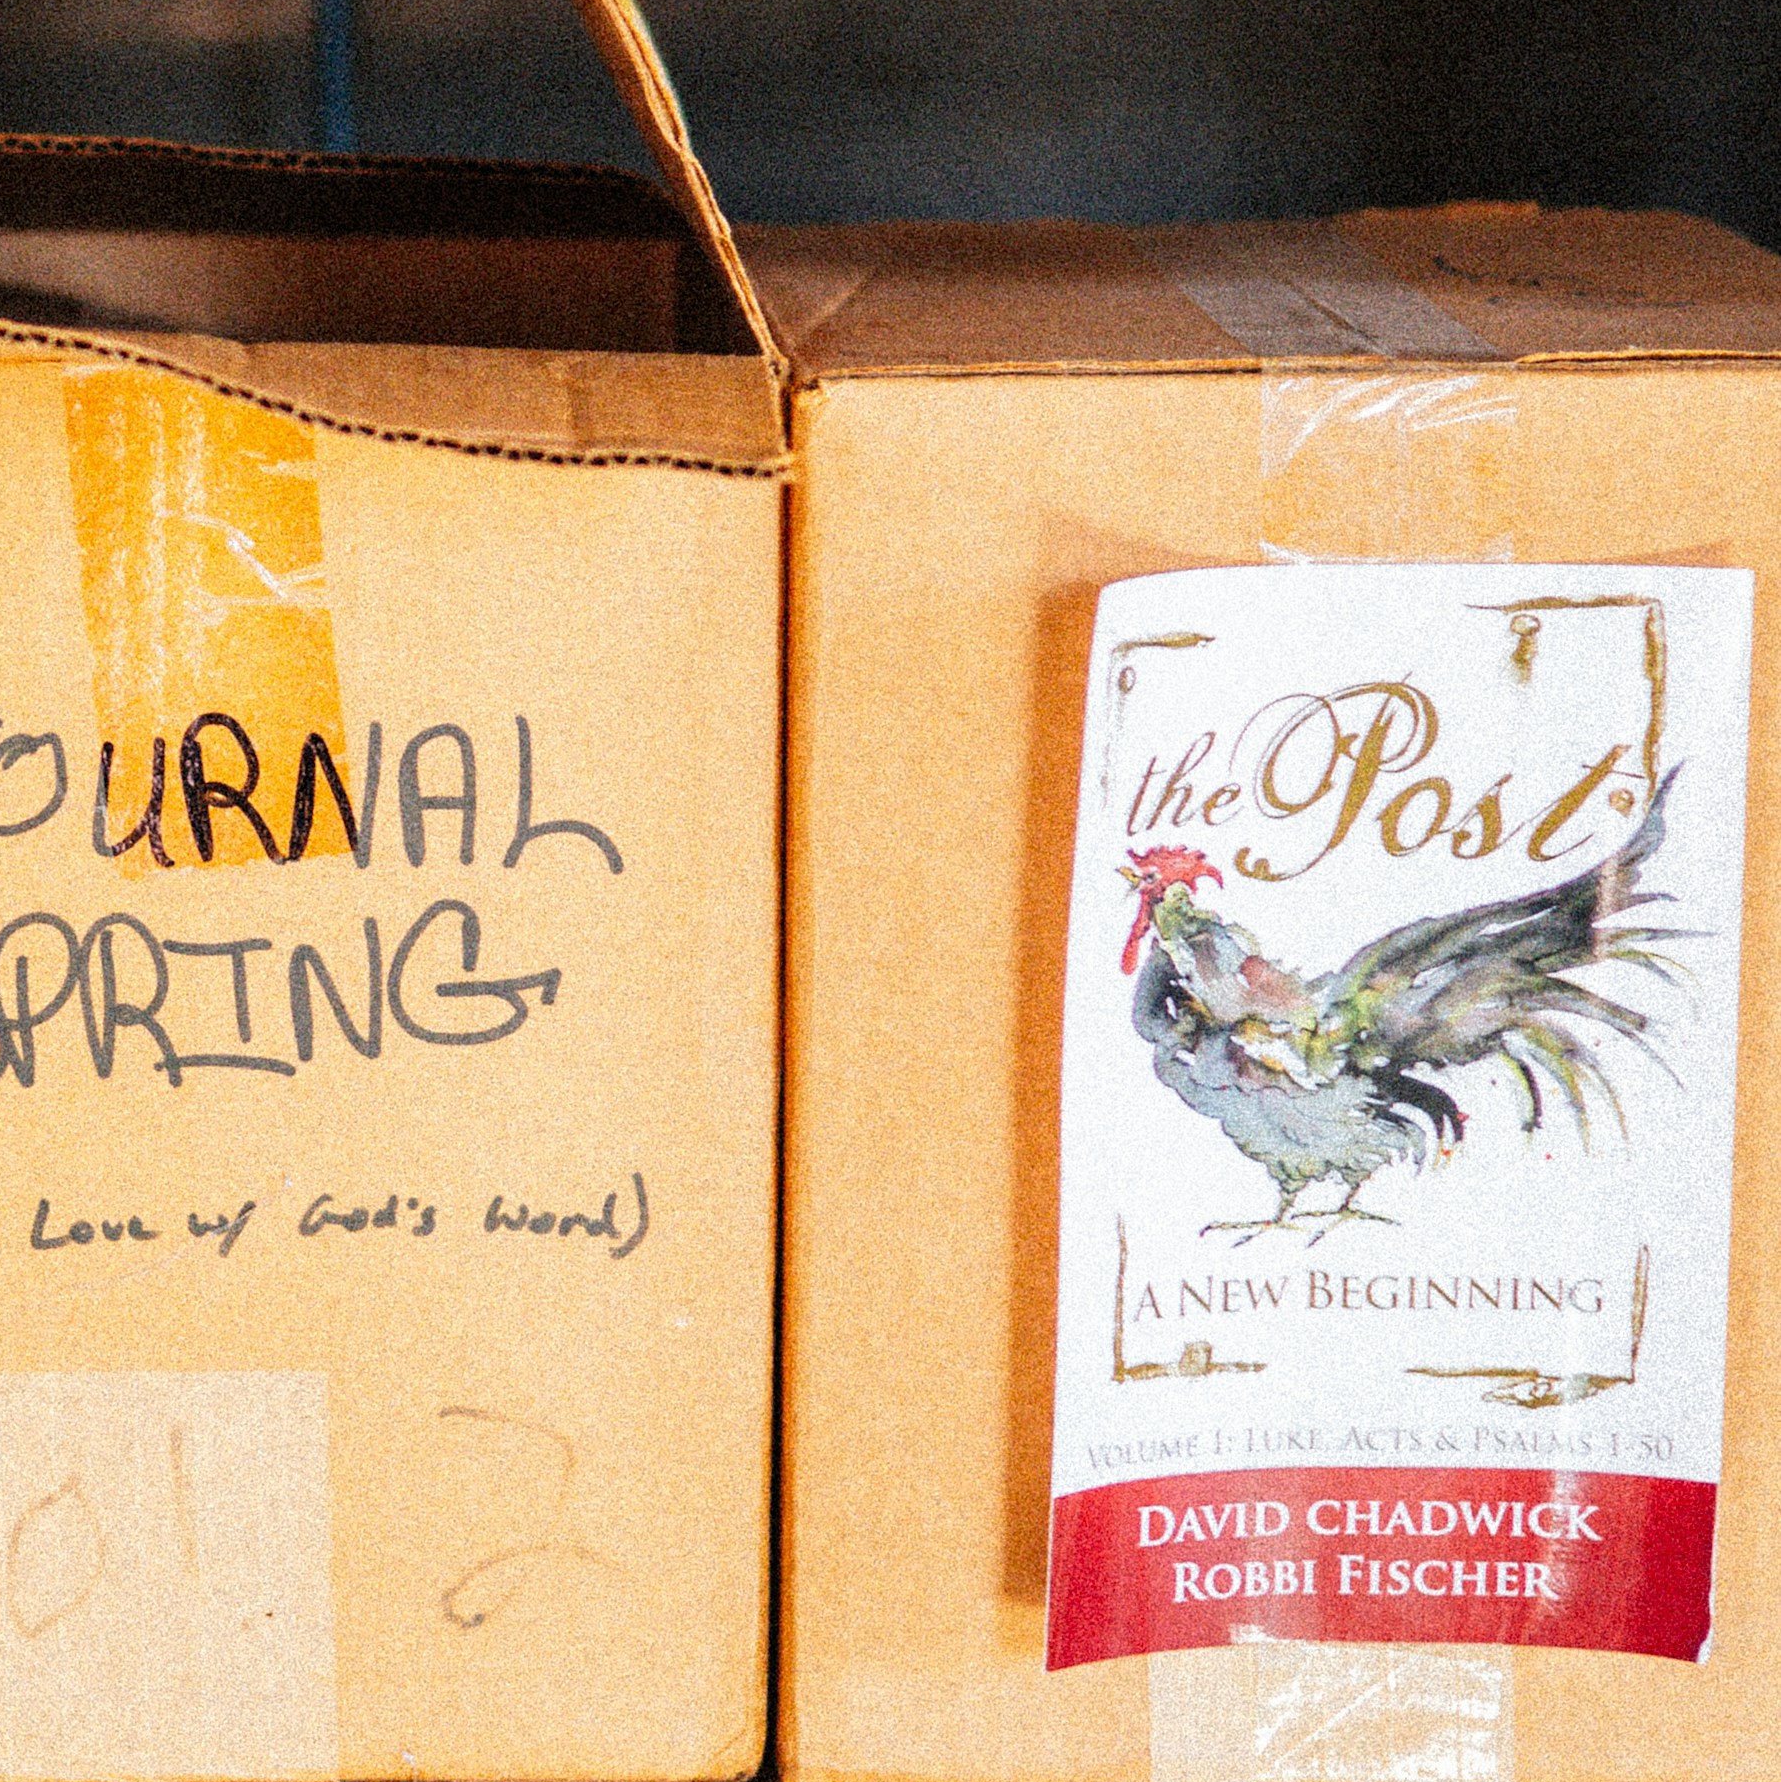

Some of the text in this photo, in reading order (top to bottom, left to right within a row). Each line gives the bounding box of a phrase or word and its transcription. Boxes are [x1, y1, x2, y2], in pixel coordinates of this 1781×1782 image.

[1126, 671, 1645, 881] the Post
[31, 1199, 156, 1251] Love
[188, 1200, 257, 1258] w/
[1133, 1282, 1163, 1322] A
[1137, 1499, 1602, 1548] DAVID CHADWICK
[1172, 1555, 1559, 1604] ROBBI FISCHER
